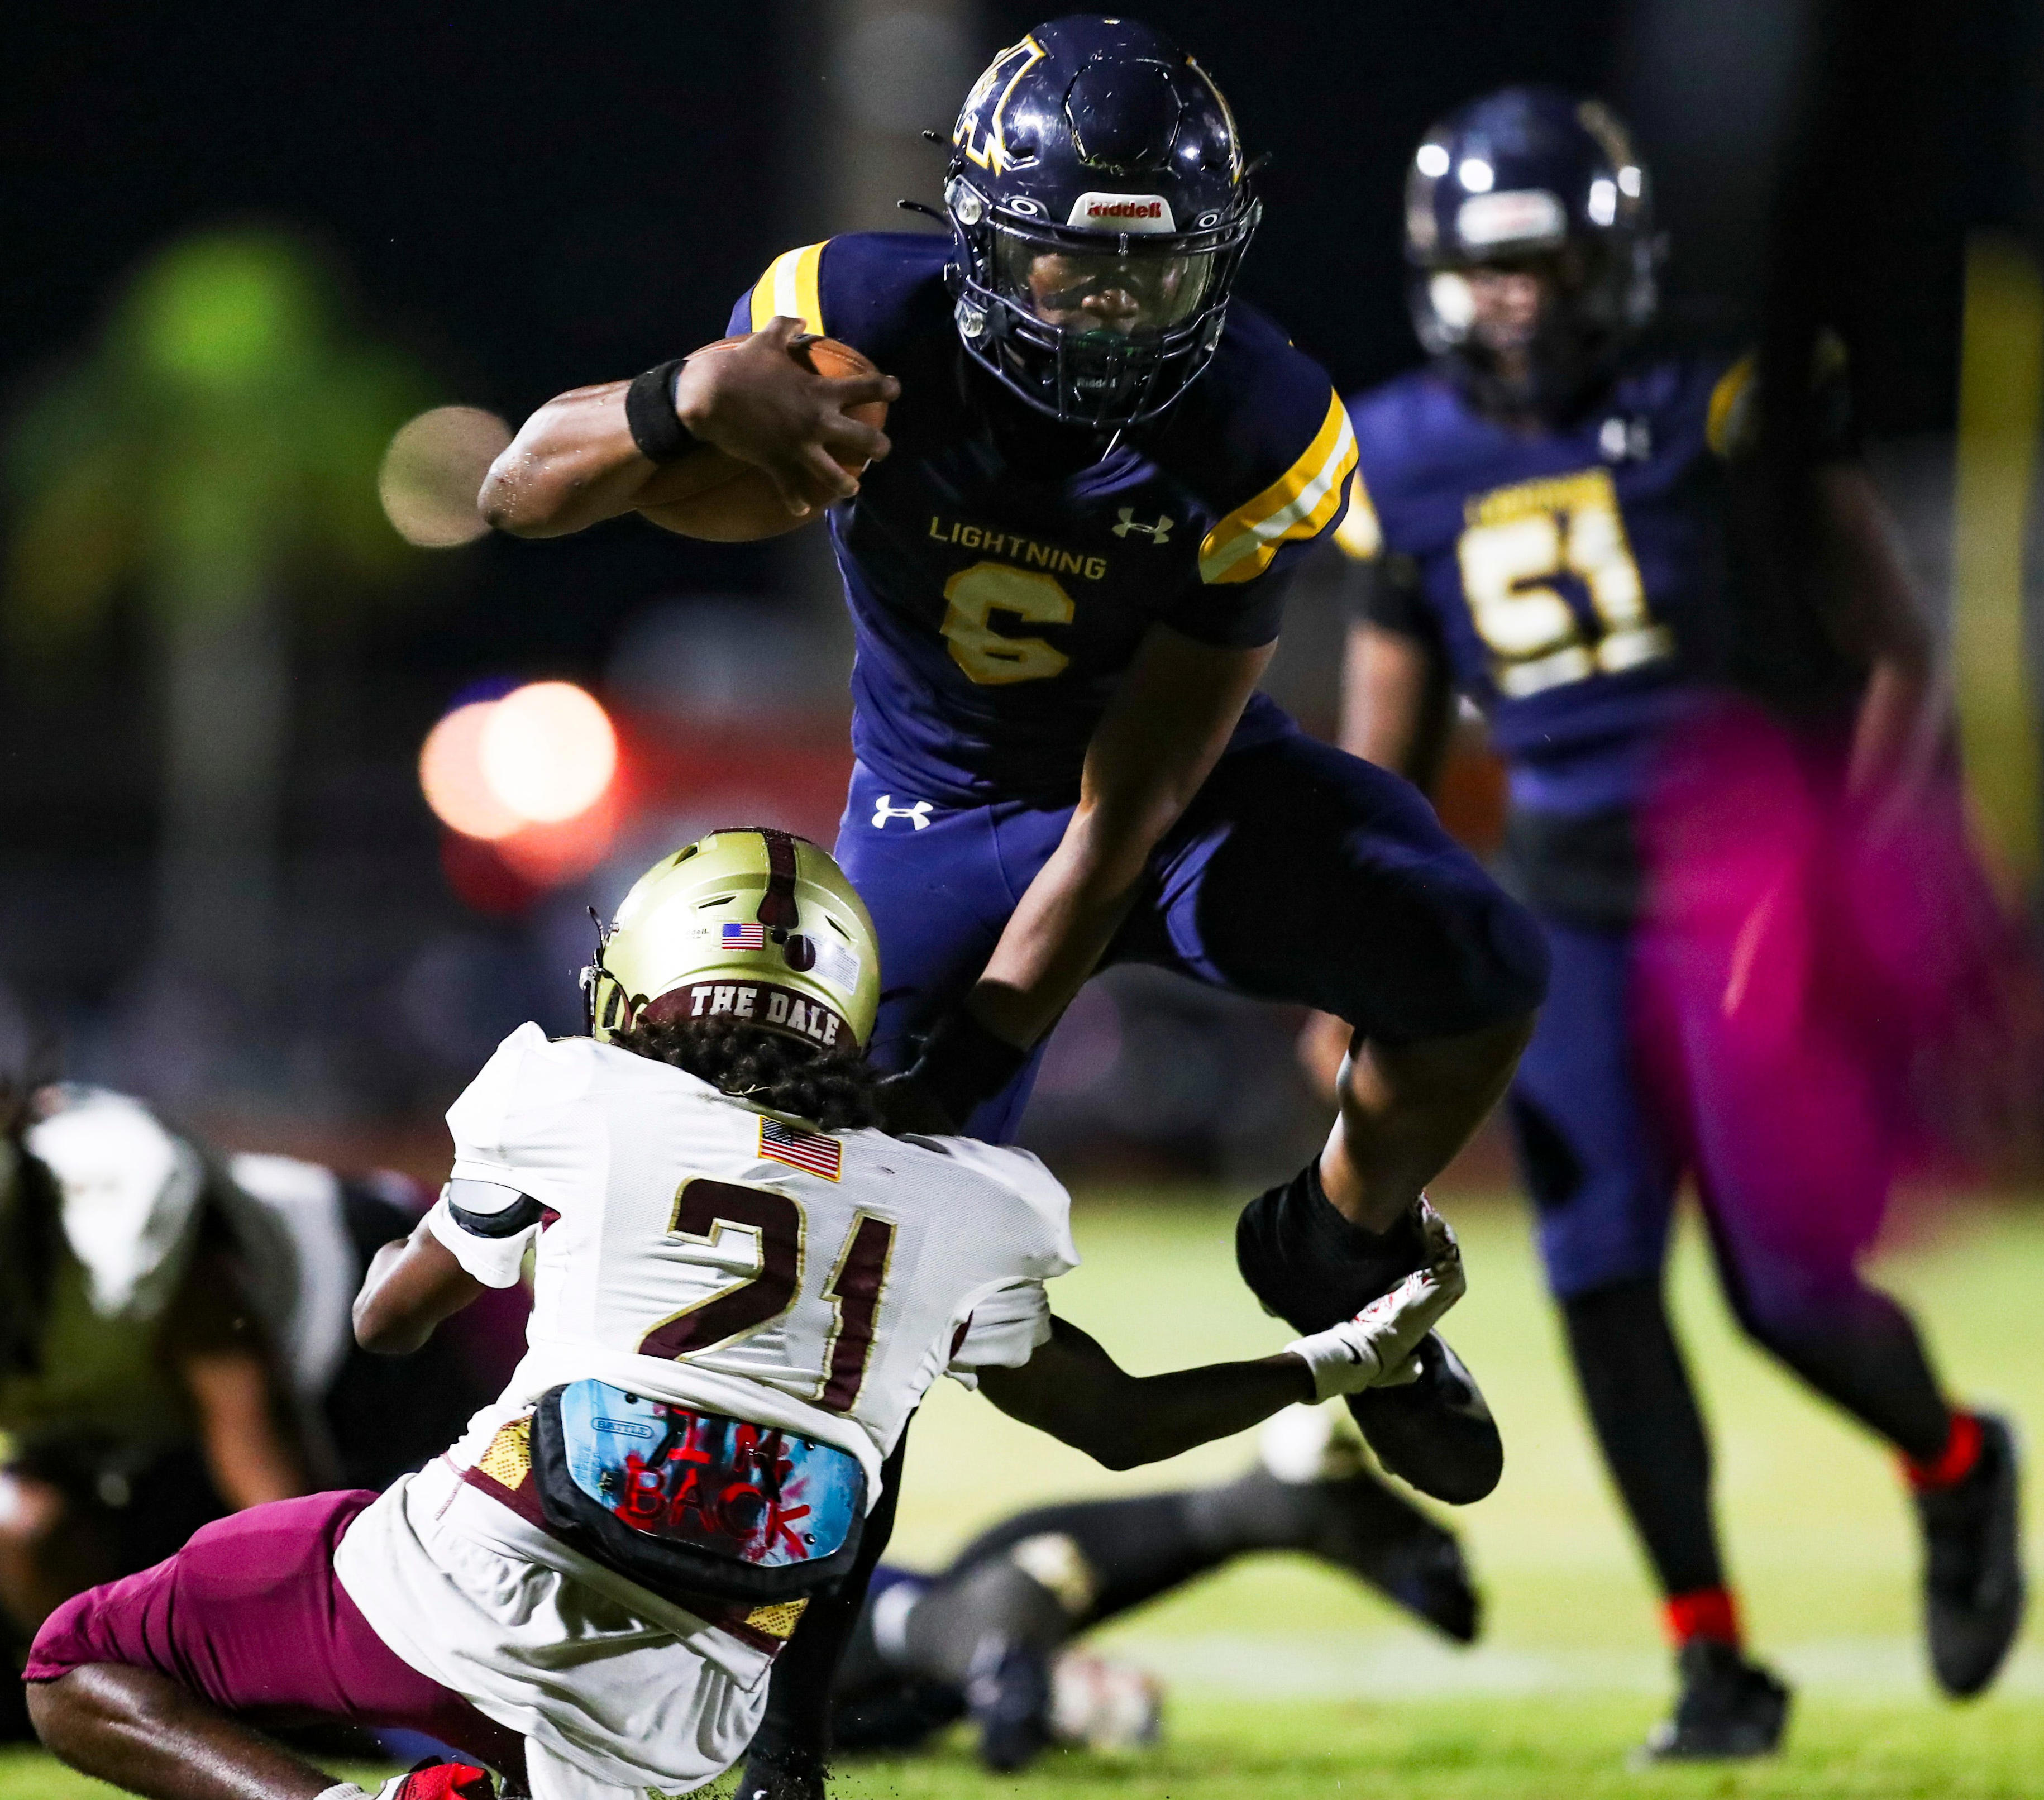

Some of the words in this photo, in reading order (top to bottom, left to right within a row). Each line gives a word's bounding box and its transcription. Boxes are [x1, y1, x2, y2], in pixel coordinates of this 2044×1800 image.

[929, 516, 1107, 580] LIGHTNING
[1458, 500, 1673, 699] 51
[939, 560, 1076, 685] 6
[690, 986, 758, 1017] THE
[766, 991, 840, 1045] DALE
[632, 1174, 898, 1414] 21
[597, 1420, 648, 1436] BATTLE
[615, 1451, 811, 1558] BACK
